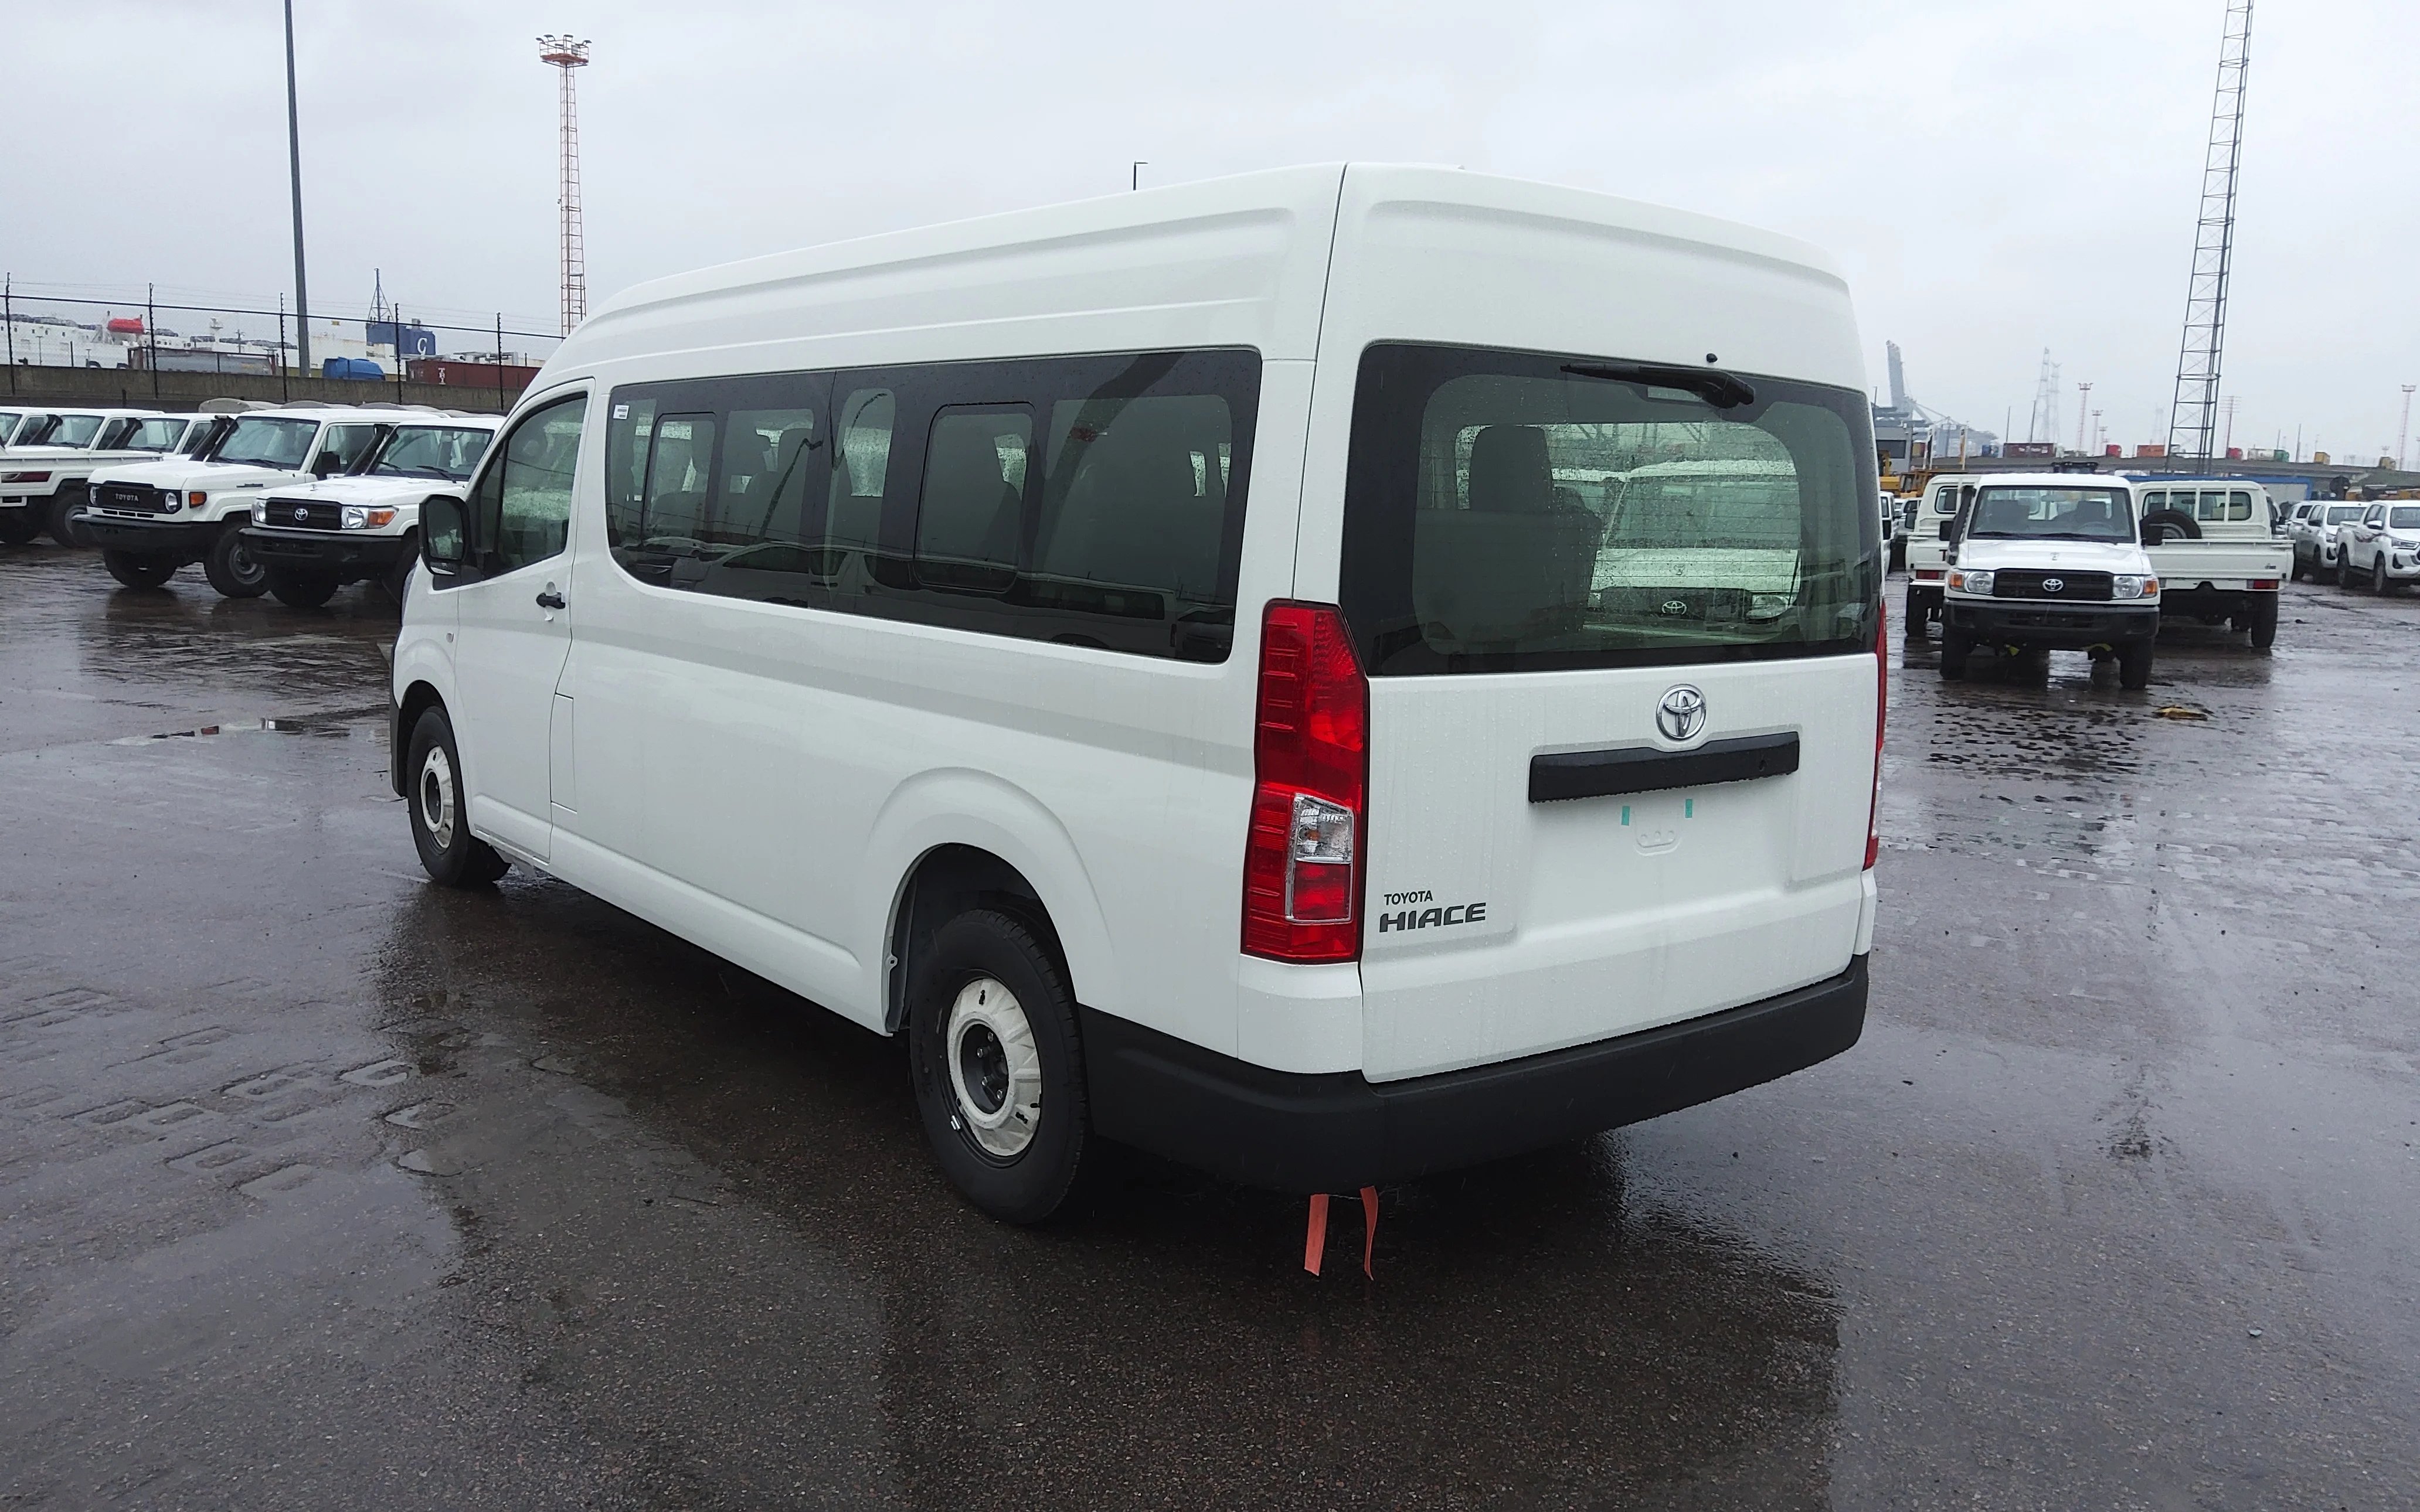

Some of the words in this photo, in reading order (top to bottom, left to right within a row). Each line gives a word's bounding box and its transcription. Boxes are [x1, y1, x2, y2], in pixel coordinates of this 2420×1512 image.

[438, 367, 446, 385] TRI
[115, 493, 139, 502] TOYOTA
[1384, 890, 1433, 905] TOYOTA
[1379, 902, 1486, 932] HIACE
